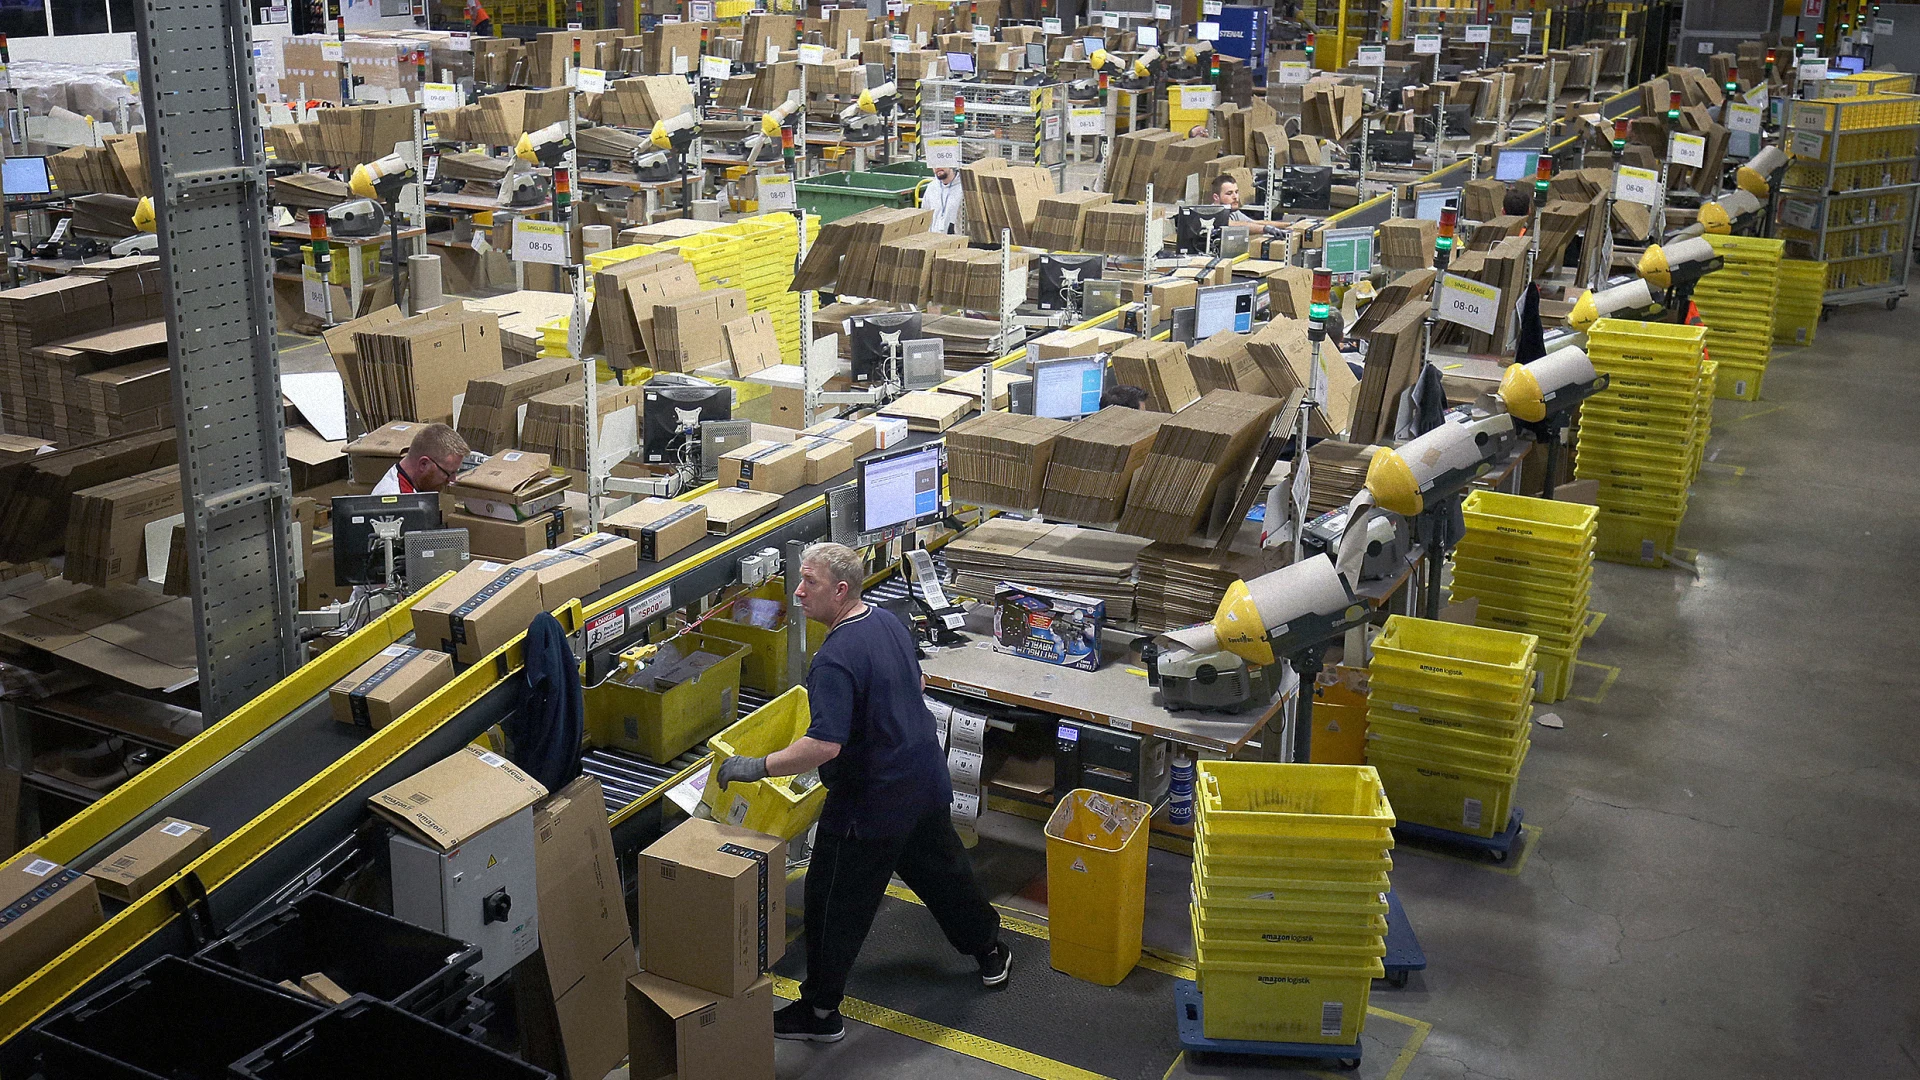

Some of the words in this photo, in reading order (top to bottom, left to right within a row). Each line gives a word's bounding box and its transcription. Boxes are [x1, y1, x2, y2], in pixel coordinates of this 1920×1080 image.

[770, 191, 786, 199] 08-07
[529, 241, 553, 252] 08-05
[1454, 281, 1471, 290] SINGLE
[1470, 286, 1486, 295] LARGE
[1453, 300, 1480, 314] 08-04
[1496, 525, 1516, 533] amazon
[599, 611, 617, 625] DANGER
[1420, 664, 1443, 673] amazon
[1443, 668, 1463, 676] logistik
[1112, 719, 1130, 728] Printer
[1419, 716, 1442, 725] amazon
[1417, 768, 1441, 776] amazon
[1262, 933, 1290, 942] amazon
[1257, 976, 1287, 984] amazon
[1287, 977, 1311, 985] logistik
